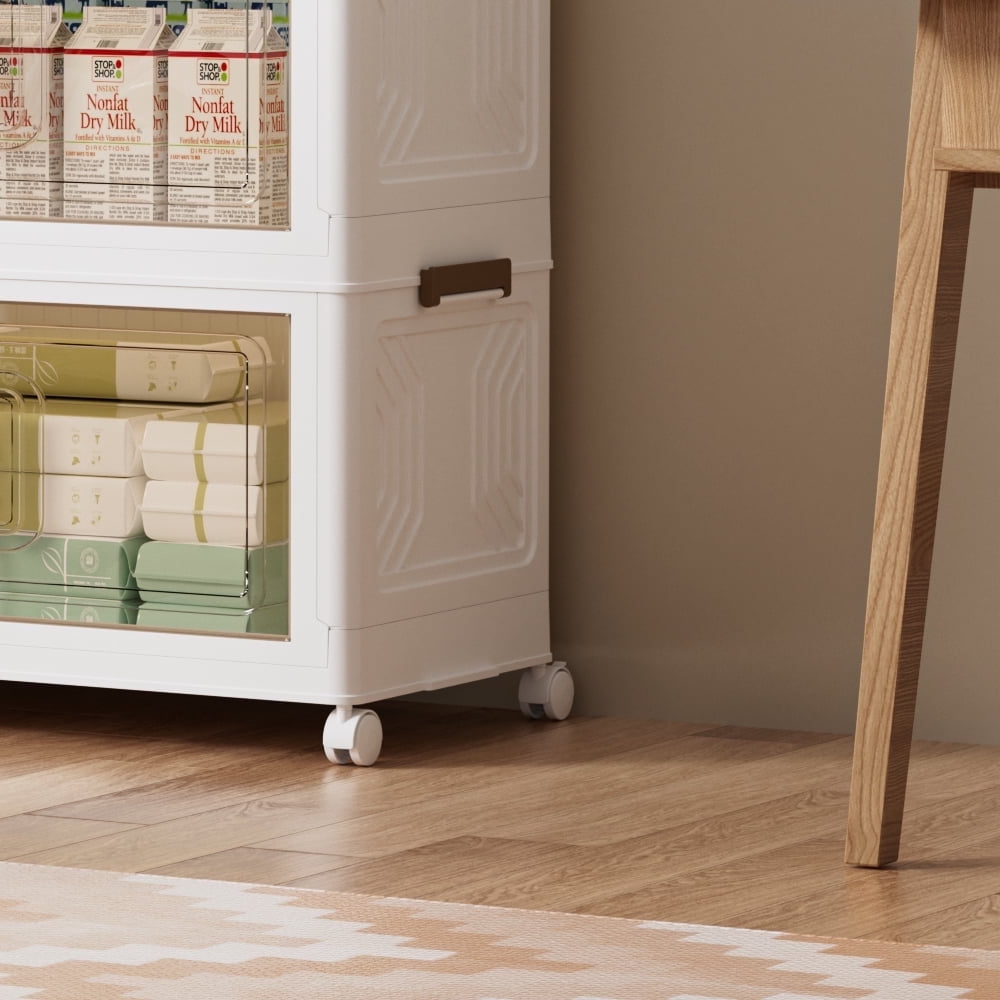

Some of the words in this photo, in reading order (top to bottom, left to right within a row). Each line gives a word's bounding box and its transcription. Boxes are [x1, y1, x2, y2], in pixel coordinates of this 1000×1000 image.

[94, 60, 113, 69] STOP
[199, 62, 218, 71] STOP
[94, 69, 114, 78] SHOP
[199, 72, 220, 80] SHOP
[87, 93, 128, 111] Nonfat
[192, 95, 234, 114] Nonfat
[80, 112, 104, 135] Dry
[107, 112, 136, 130] Milk
[184, 115, 209, 138] Dry
[213, 115, 242, 133] Milk
